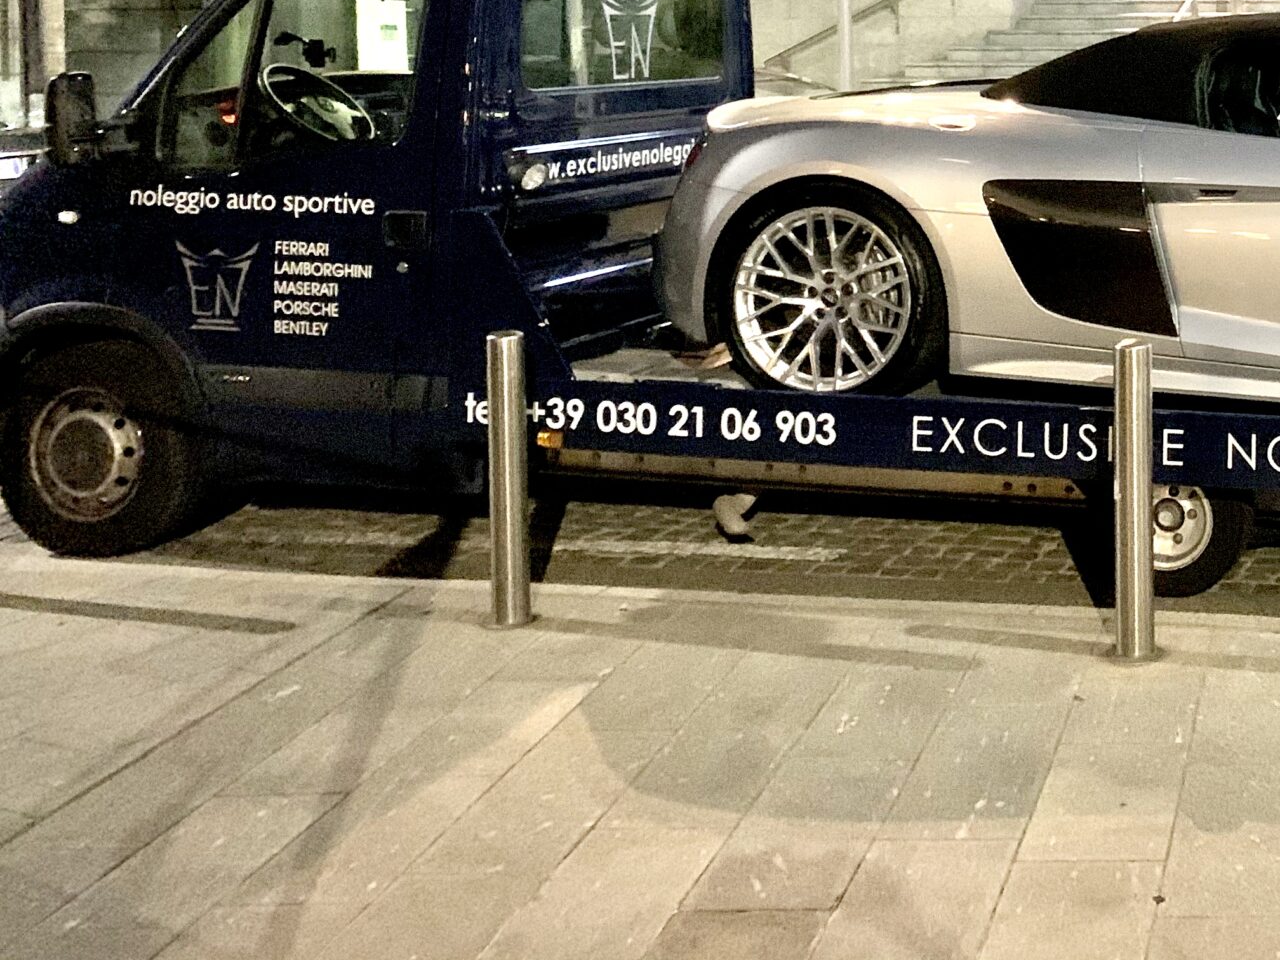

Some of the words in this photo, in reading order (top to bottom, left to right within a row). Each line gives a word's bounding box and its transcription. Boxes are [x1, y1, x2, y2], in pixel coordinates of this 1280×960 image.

[129, 183, 220, 215] noleggio
[226, 192, 277, 211] auto
[282, 191, 375, 219] sportive
[274, 240, 330, 257] FERRARI
[273, 260, 373, 279] LAMBORGHINI
[273, 280, 339, 297] MASERATI
[273, 299, 340, 318] PORSCHE
[273, 320, 329, 337] BENTLEY
[464, 392, 489, 425] te
[526, 396, 585, 430] +39
[596, 400, 658, 436] 030
[667, 404, 704, 438] 21
[720, 407, 762, 442] 06
[775, 409, 837, 446] 903
[911, 415, 1185, 467] EXCLUSIE
